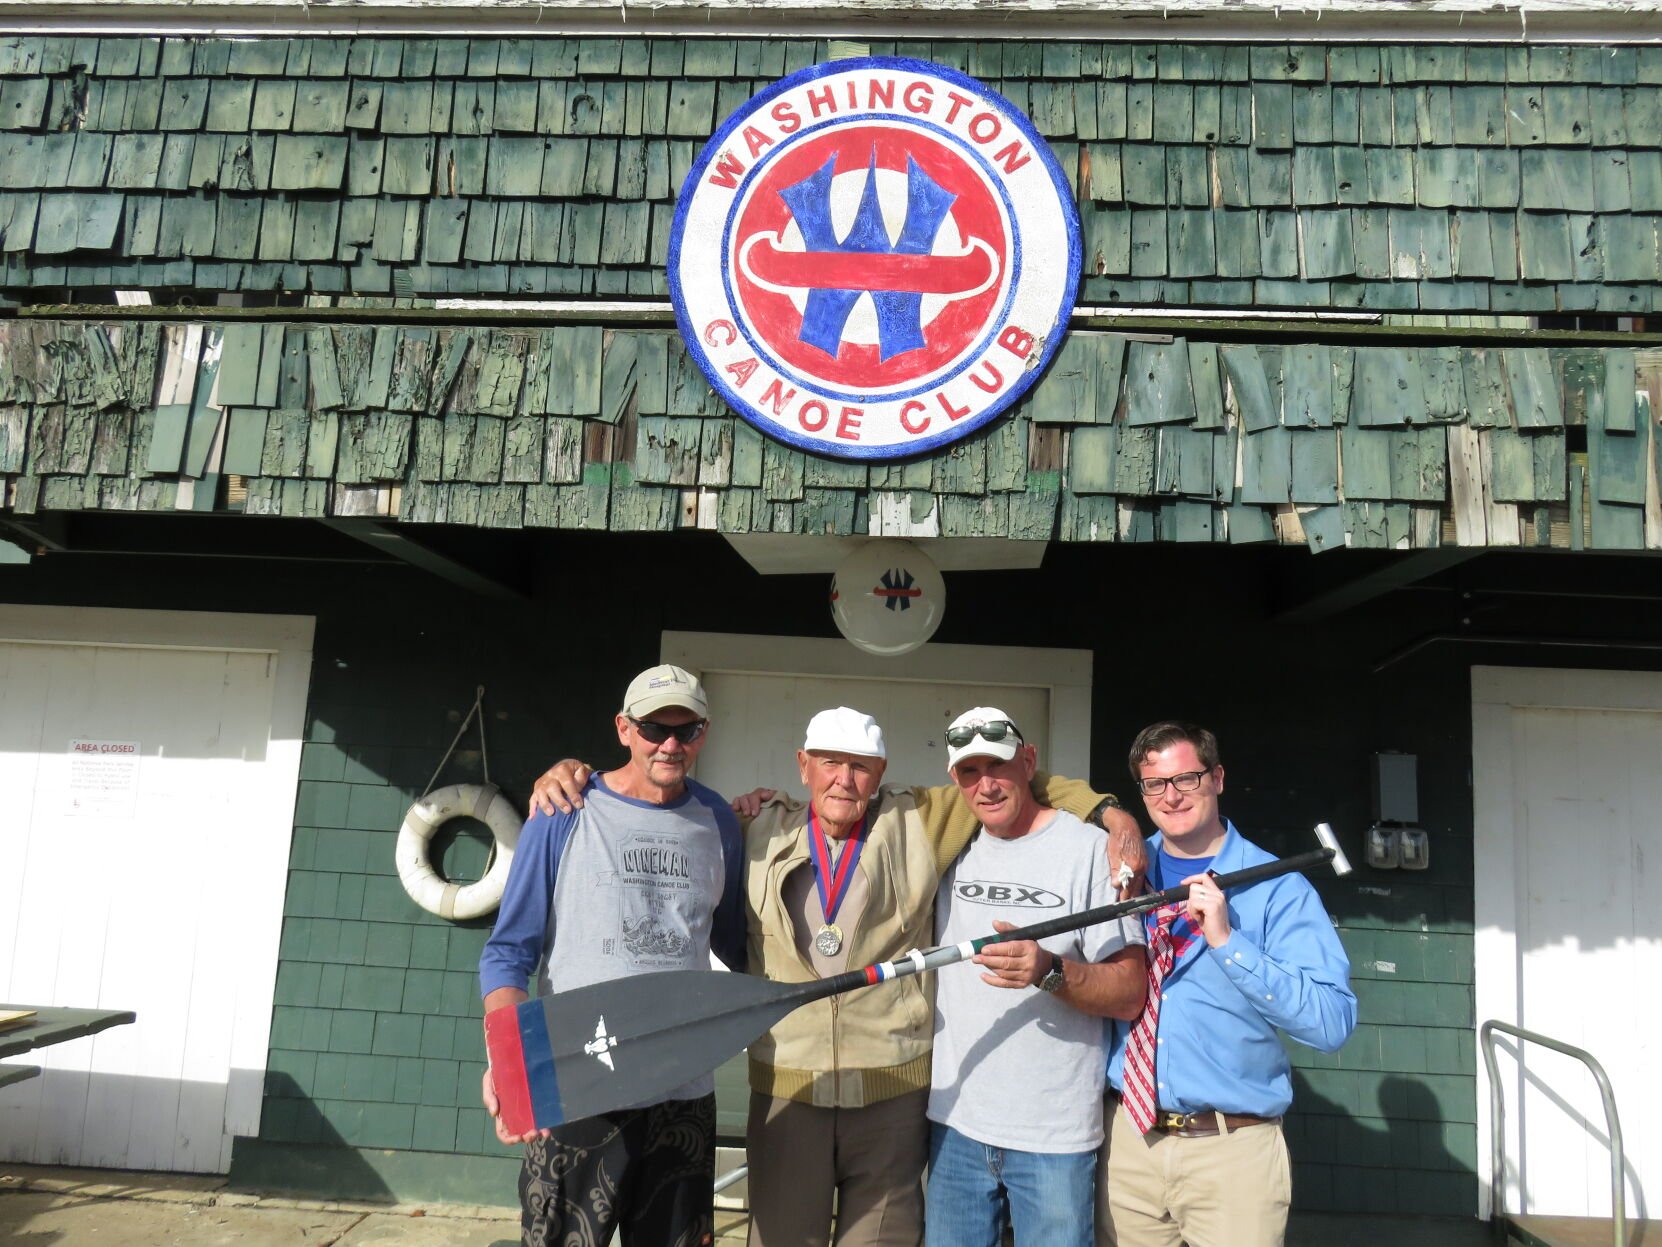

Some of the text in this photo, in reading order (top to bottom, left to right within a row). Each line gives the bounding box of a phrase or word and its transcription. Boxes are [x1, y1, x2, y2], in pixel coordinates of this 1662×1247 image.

[709, 79, 1031, 190] WASHINGTON
[703, 318, 1036, 440] CANOE CLUB
[75, 743, 135, 753] AREA CLOSED
[623, 848, 690, 878] NINEMAN
[623, 877, 690, 890] WASHINGTON CANOE CLUB
[960, 884, 1046, 905] OBX
